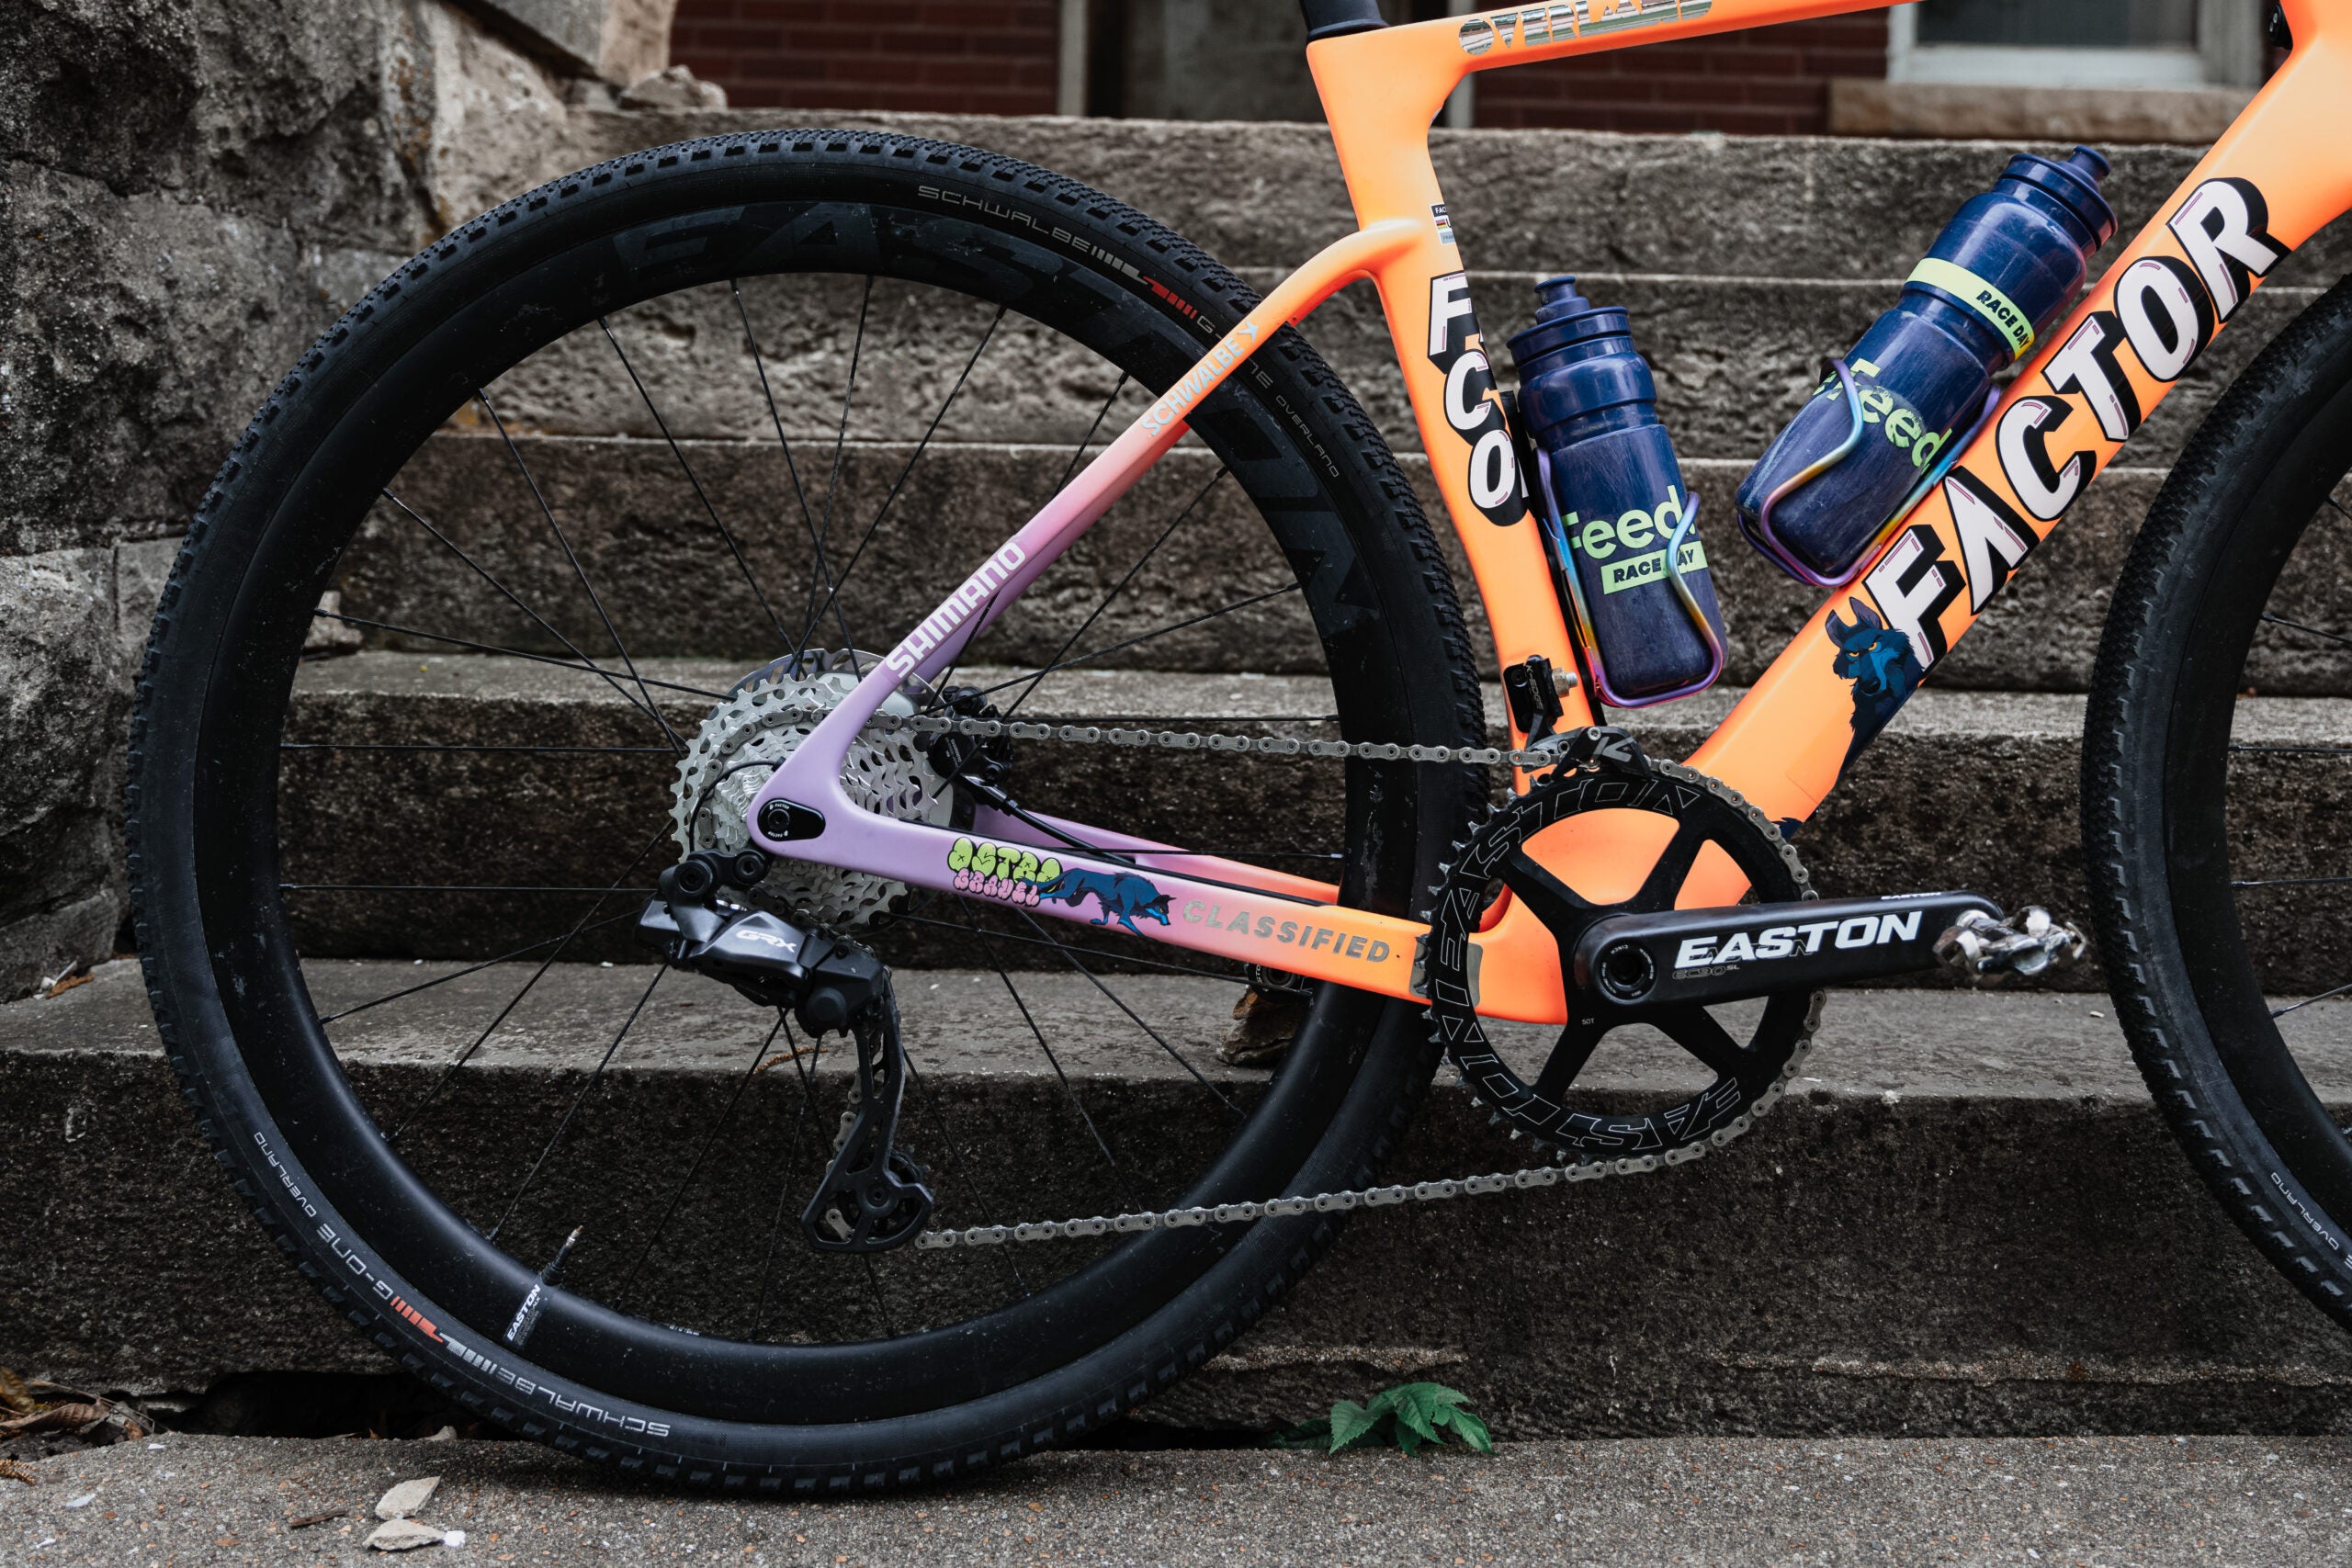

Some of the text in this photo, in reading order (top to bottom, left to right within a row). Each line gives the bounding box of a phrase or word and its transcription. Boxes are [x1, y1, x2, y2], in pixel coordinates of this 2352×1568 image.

[918, 185, 1092, 254] SCHWALBE
[1975, 289, 2030, 348] RACE DAY
[1141, 336, 1246, 438] SCHWALBE
[1274, 394, 1340, 478] OVERLAND
[1861, 176, 2295, 674] FACTOR
[1613, 557, 1662, 583] RACE
[887, 542, 1025, 679] SHIMANO
[954, 867, 1041, 907] GRAVEL
[735, 929, 798, 953] GRX
[1183, 899, 1391, 963] CLASSIFIED
[1673, 911, 1922, 970] EASTON
[253, 1132, 317, 1218] OVERLAND
[2270, 1172, 2339, 1250] OVERLAND
[316, 1222, 393, 1301] G-ONE
[506, 1283, 541, 1341] EASTON
[497, 1367, 671, 1438] SCHWALBE
